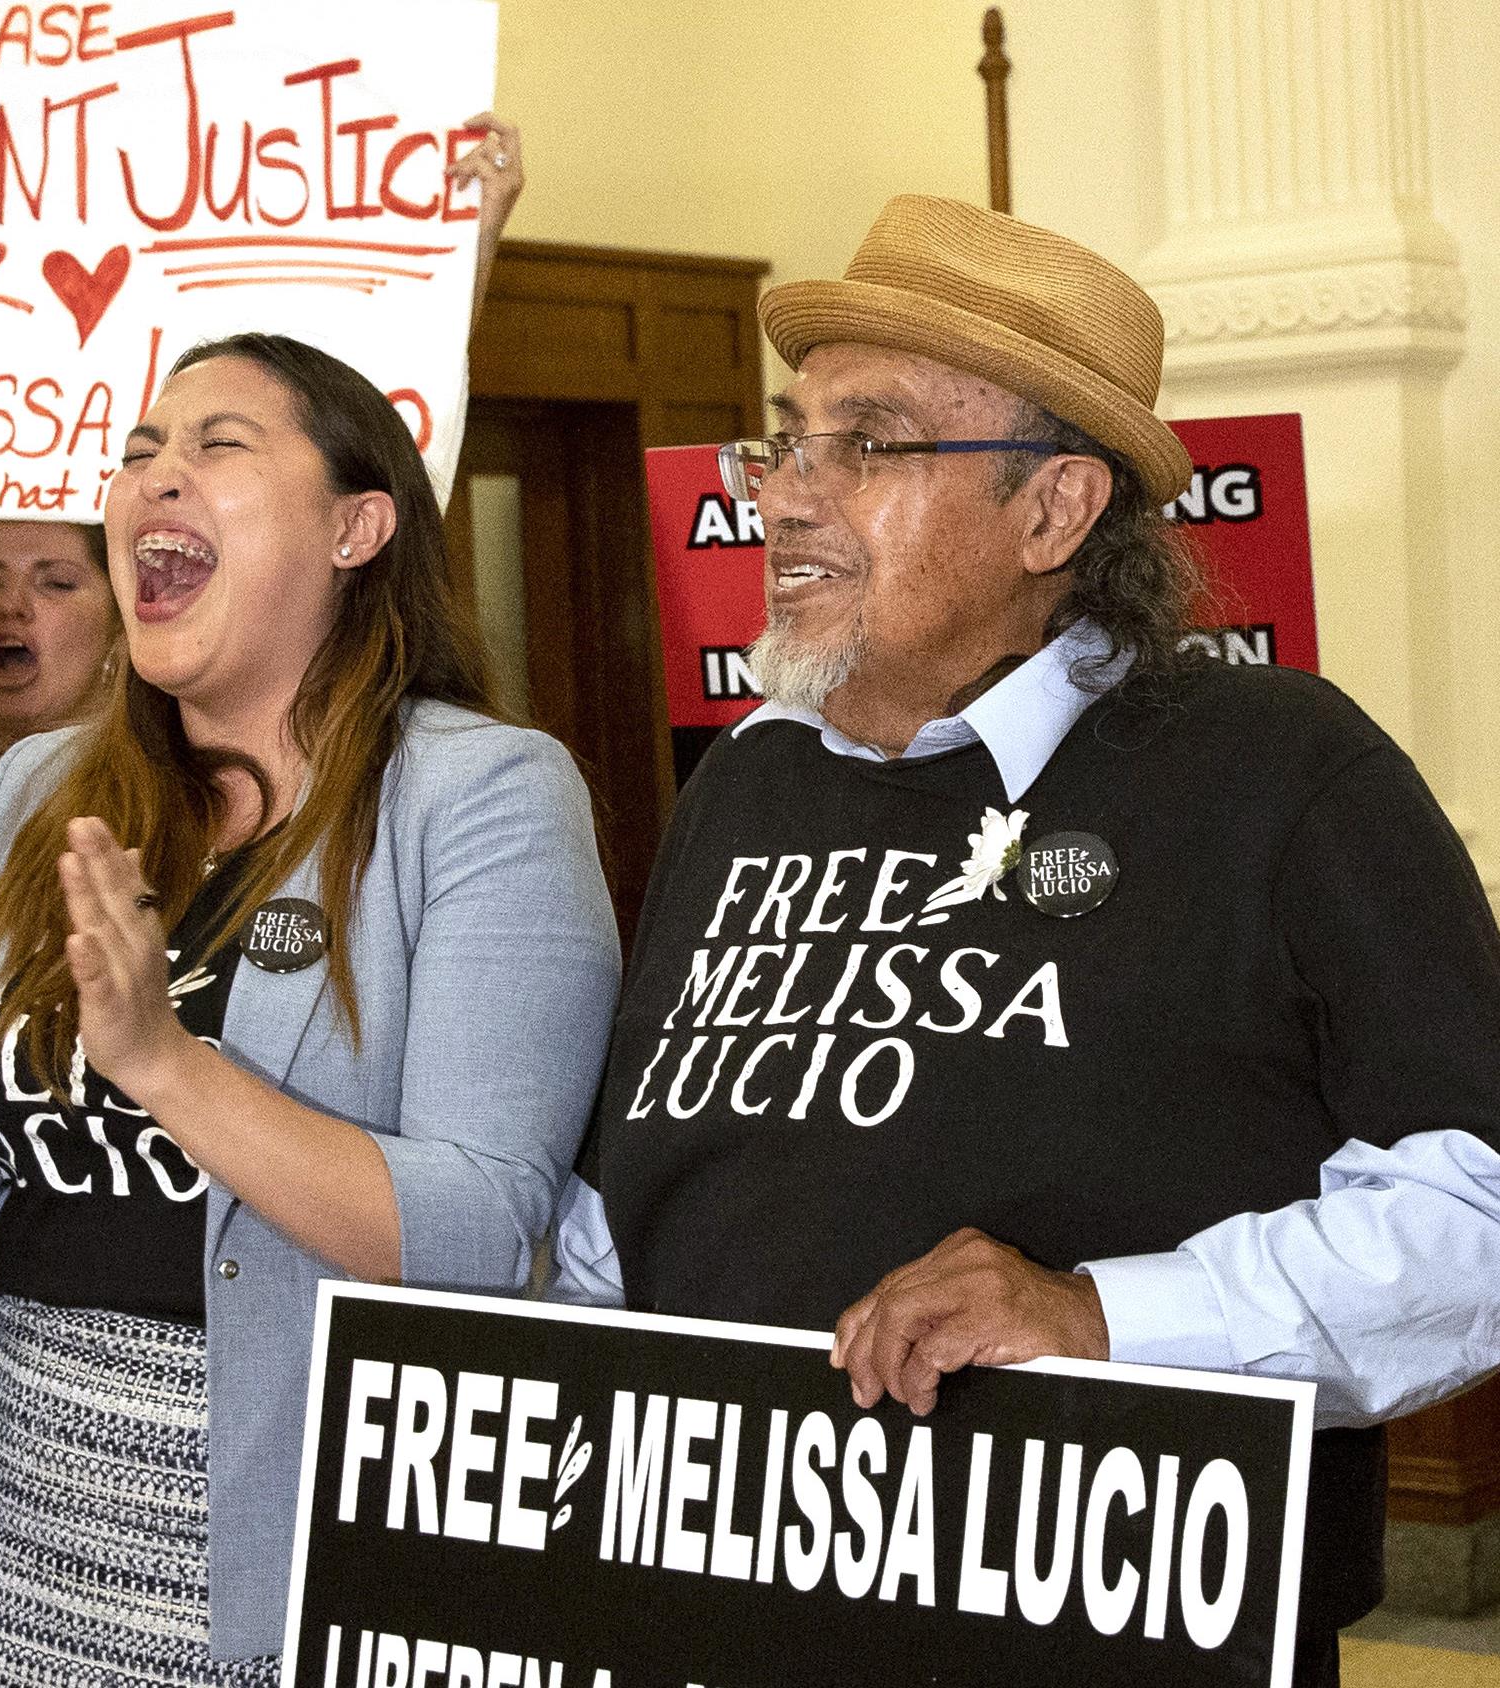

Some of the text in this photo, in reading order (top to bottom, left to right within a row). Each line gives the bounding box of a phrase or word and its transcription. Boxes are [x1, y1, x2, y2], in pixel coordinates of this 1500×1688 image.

[116, 11, 490, 232] JUSTICE
[1030, 847, 1080, 867] FREE
[1030, 860, 1112, 882] MELISSA
[704, 848, 938, 938] FREE
[1031, 877, 1092, 898] LUCIO
[255, 911, 301, 927] FREE
[252, 924, 323, 943] MELISSA
[249, 937, 303, 954] LUCIO
[663, 943, 1070, 1048] MELISSA
[627, 1033, 915, 1127] LUCIO
[338, 1358, 1250, 1650] FREE MELISSA LUCIO
